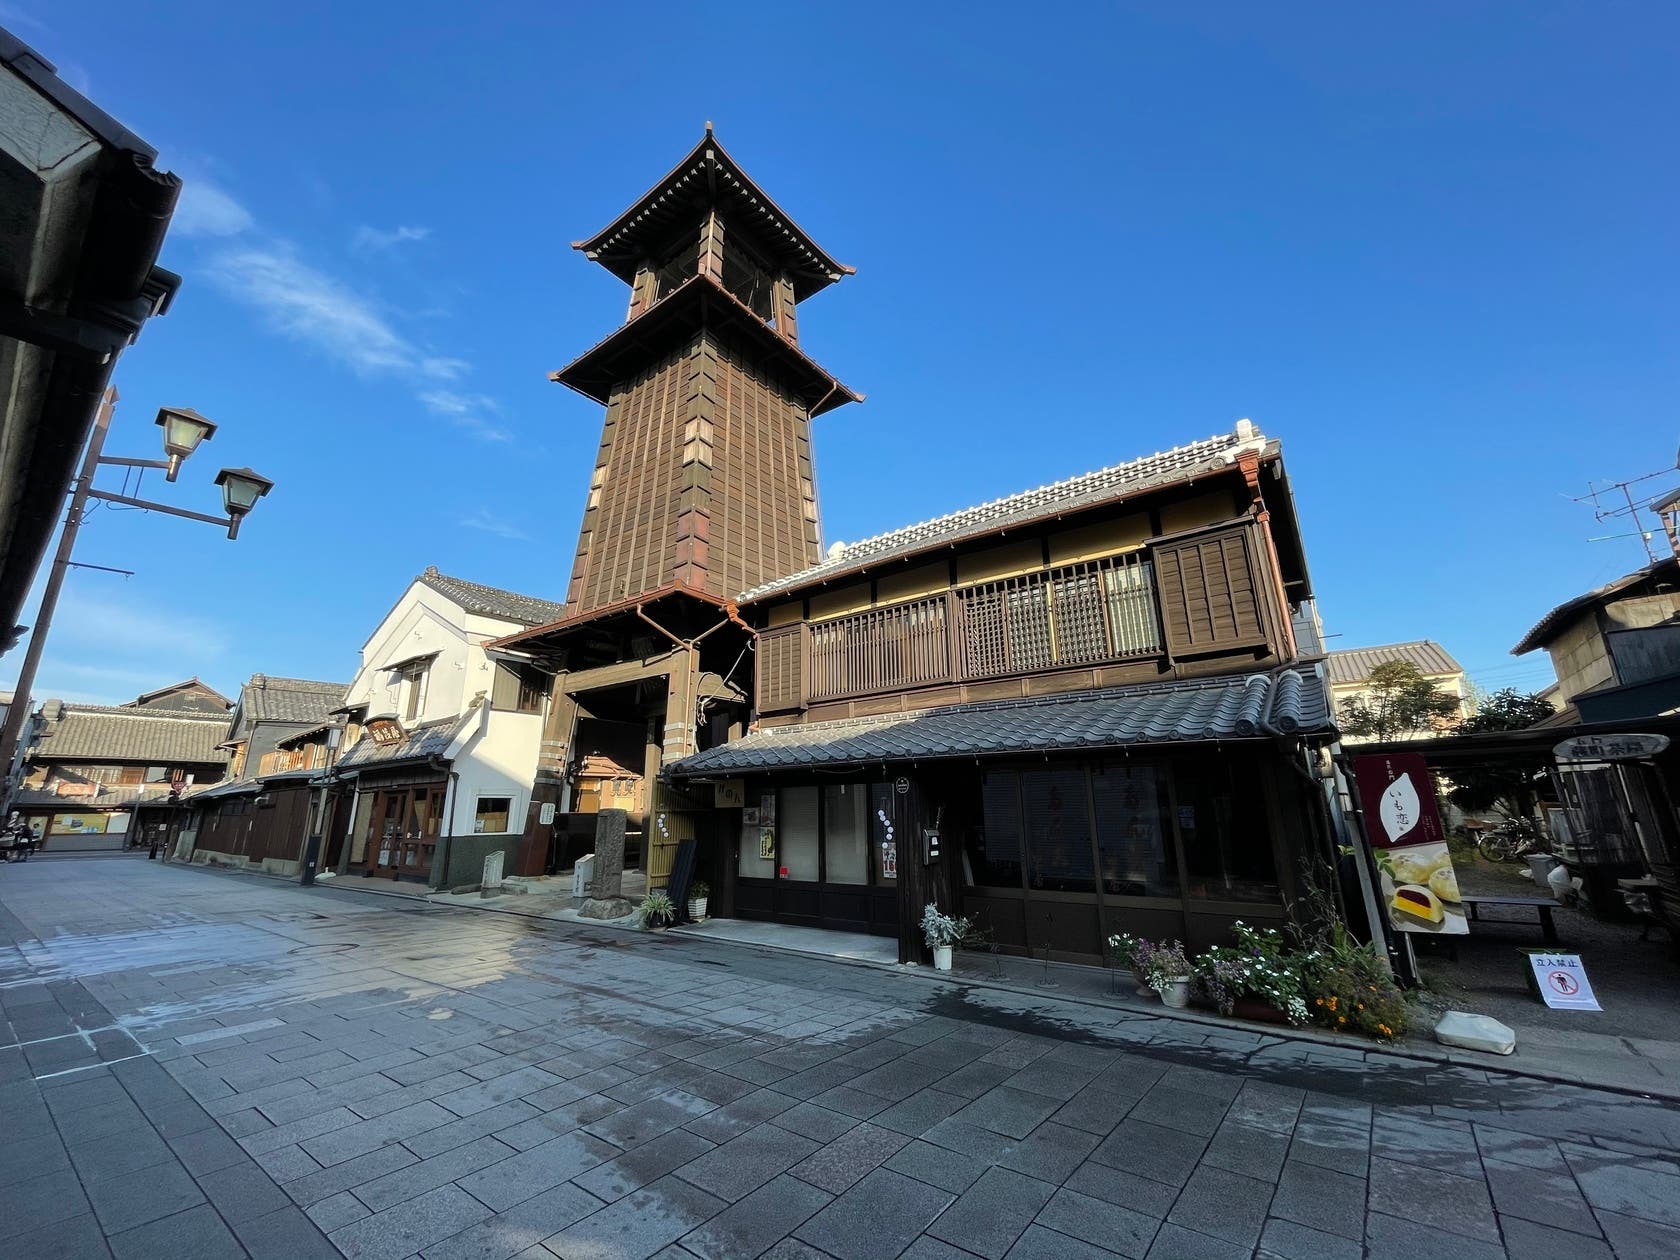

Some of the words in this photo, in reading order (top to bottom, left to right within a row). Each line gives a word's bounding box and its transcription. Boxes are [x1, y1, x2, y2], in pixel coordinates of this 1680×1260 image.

[1389, 791, 1409, 825] いも恋
[1536, 958, 1579, 967] 立入禁止
